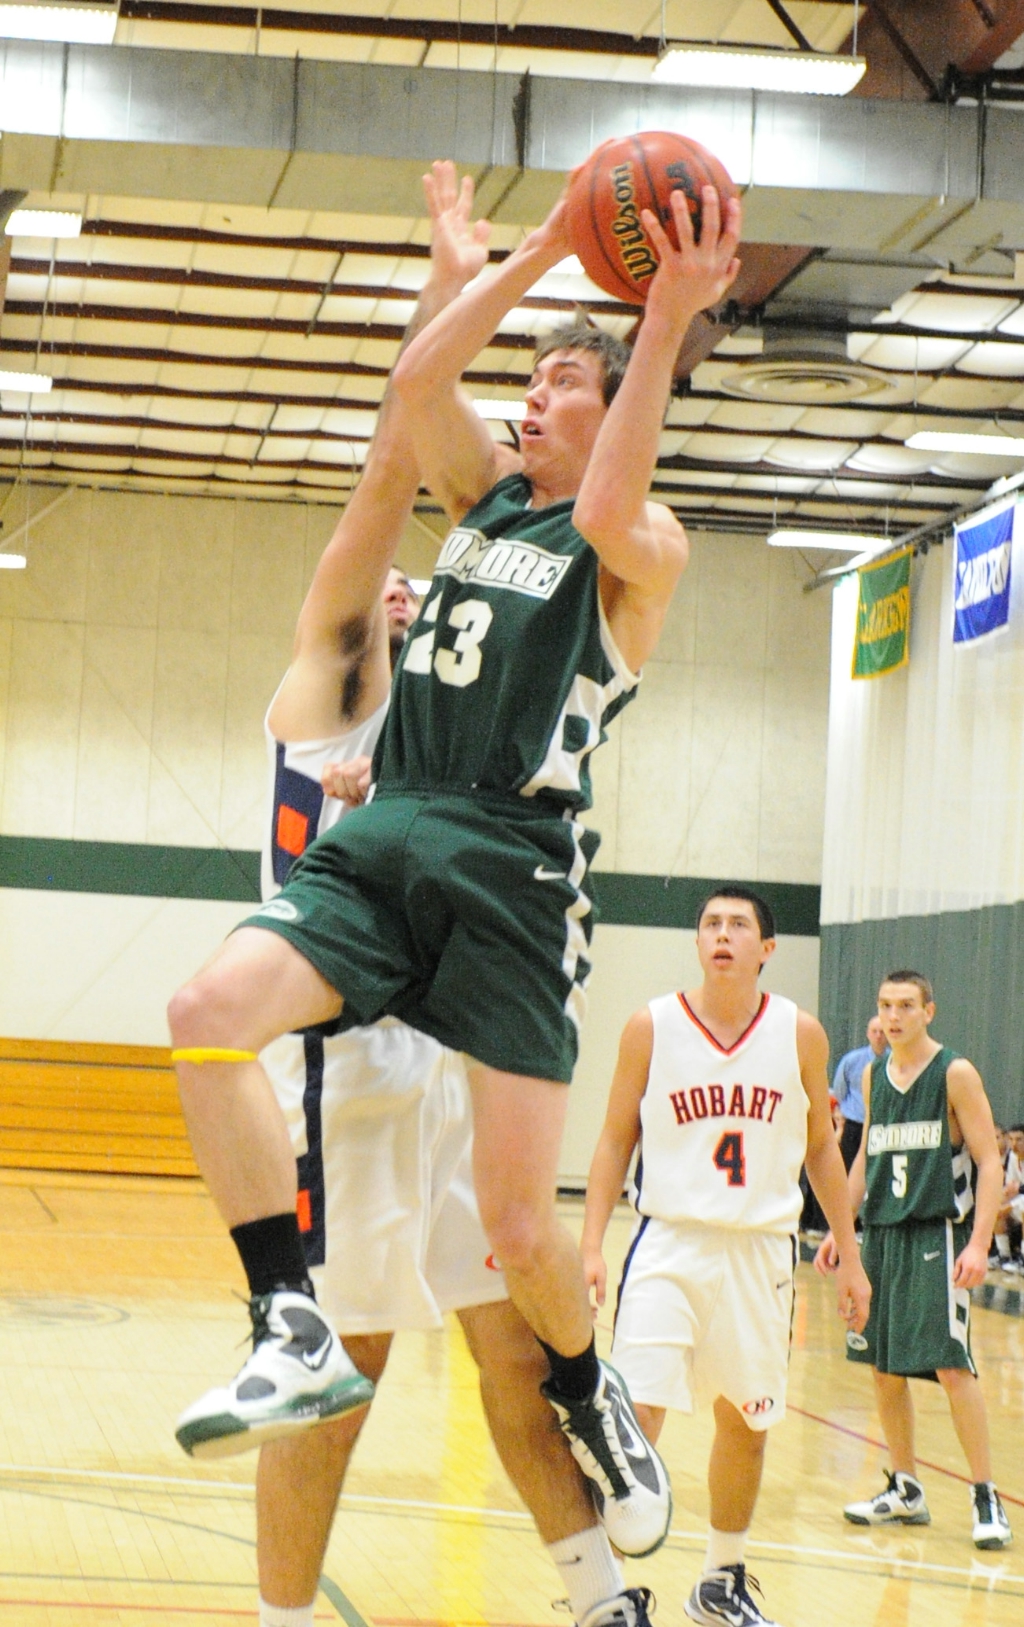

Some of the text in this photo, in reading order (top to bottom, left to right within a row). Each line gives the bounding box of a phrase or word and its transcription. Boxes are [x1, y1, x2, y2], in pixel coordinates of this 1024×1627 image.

[611, 161, 659, 282] Wilson
[669, 1084, 783, 1125] HOBART
[712, 1130, 746, 1187] 4
[892, 1154, 908, 1198] 5
